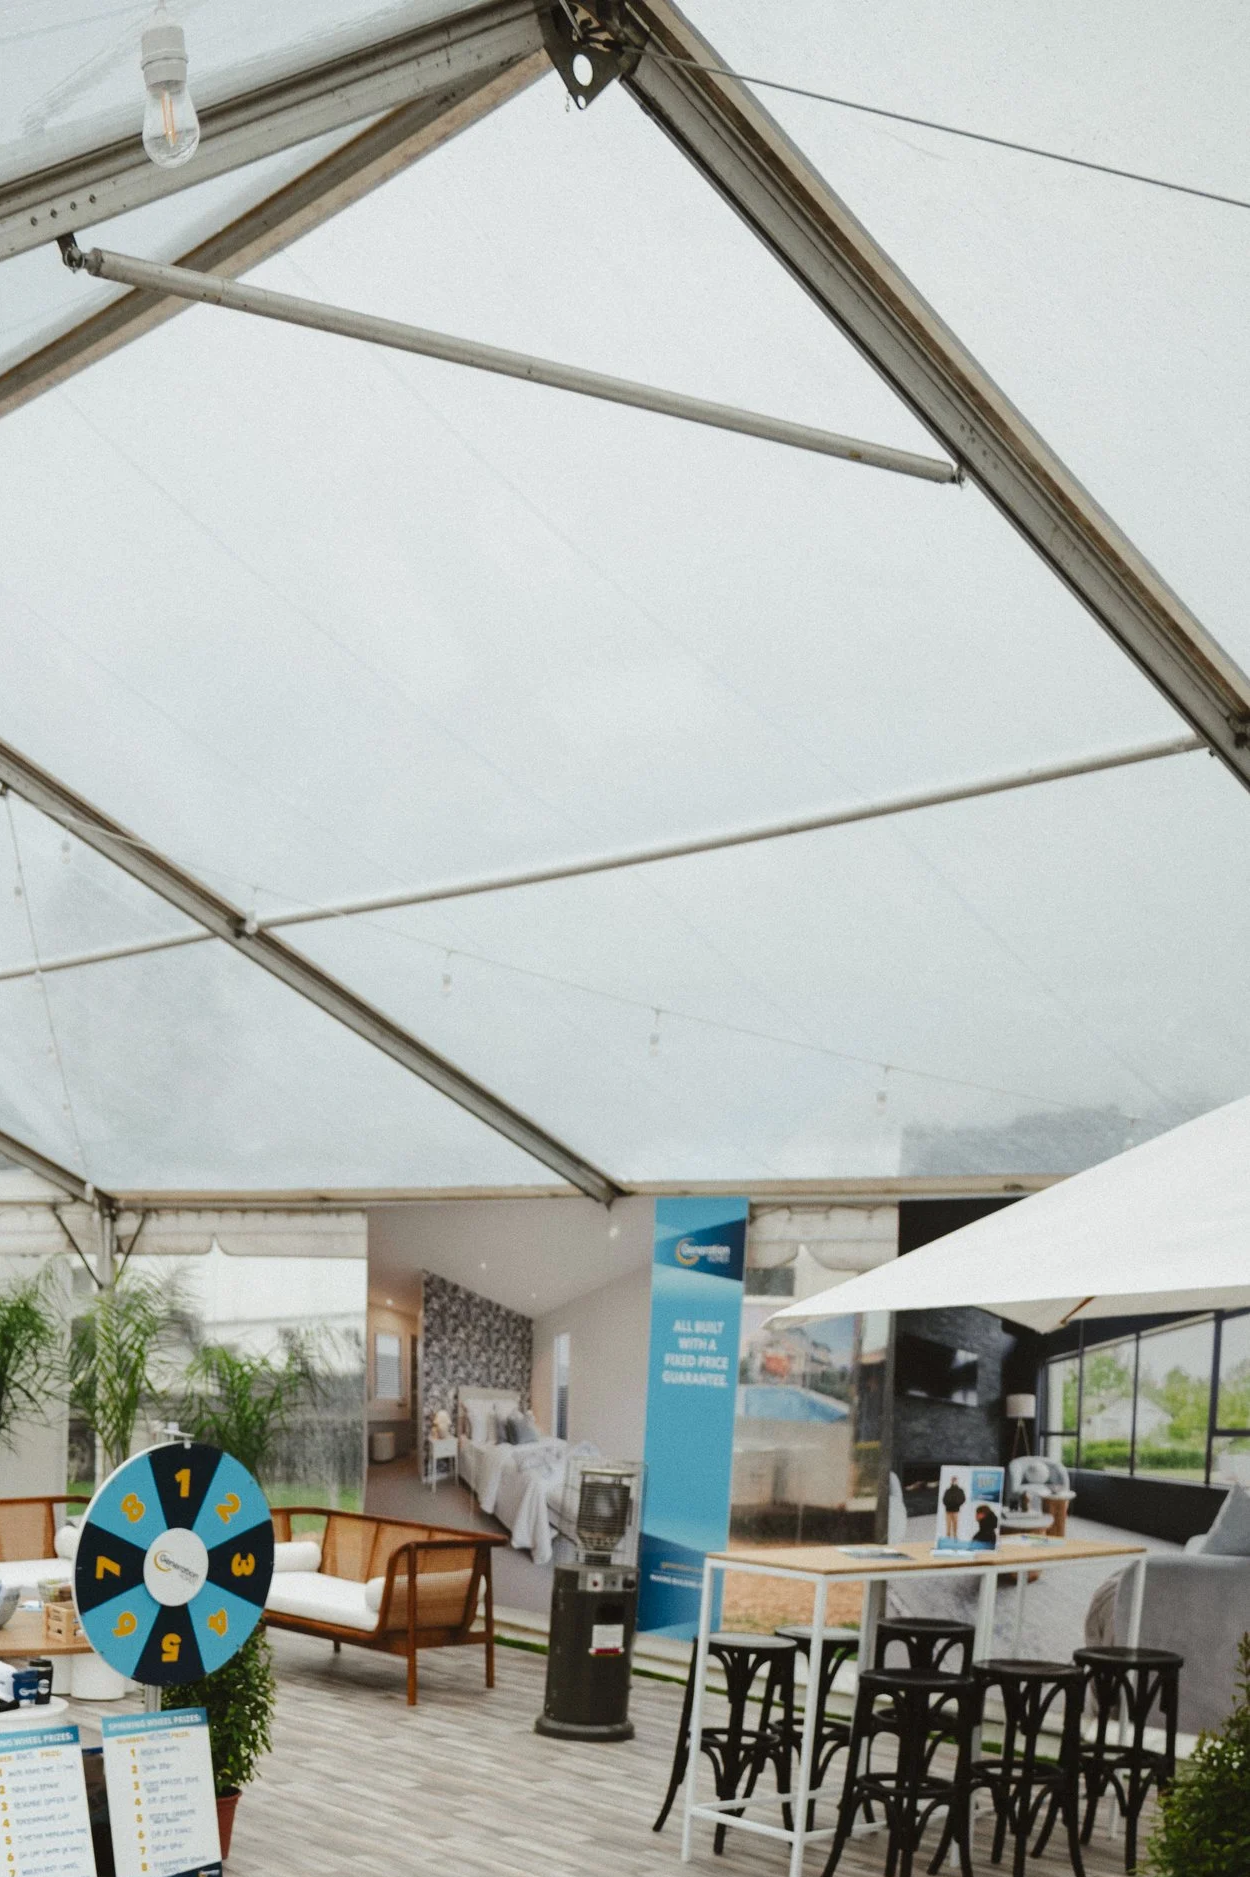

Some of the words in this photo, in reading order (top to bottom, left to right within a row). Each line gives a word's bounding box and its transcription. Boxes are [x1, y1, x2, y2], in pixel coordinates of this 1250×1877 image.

[673, 1320, 693, 1333] ALL
[694, 1320, 725, 1335] BUILT
[678, 1337, 706, 1350] WITH
[707, 1339, 718, 1351] A
[664, 1353, 696, 1368] FIXED
[698, 1356, 729, 1370] PRICE
[174, 1468, 191, 1498] 1
[120, 1492, 145, 1523] 8
[215, 1493, 241, 1523] 2
[95, 1555, 121, 1580] 7
[160, 1554, 199, 1578] Generation
[231, 1552, 255, 1577] 3
[111, 1611, 137, 1638] 6
[207, 1608, 228, 1637] 4
[161, 1633, 182, 1662] 5
[108, 1720, 146, 1731] SPINNING
[147, 1717, 173, 1727] WHEEL
[173, 1714, 202, 1724] PRIZES:
[14, 1736, 43, 1746] WHEEL
[44, 1732, 73, 1743] PRIZES:
